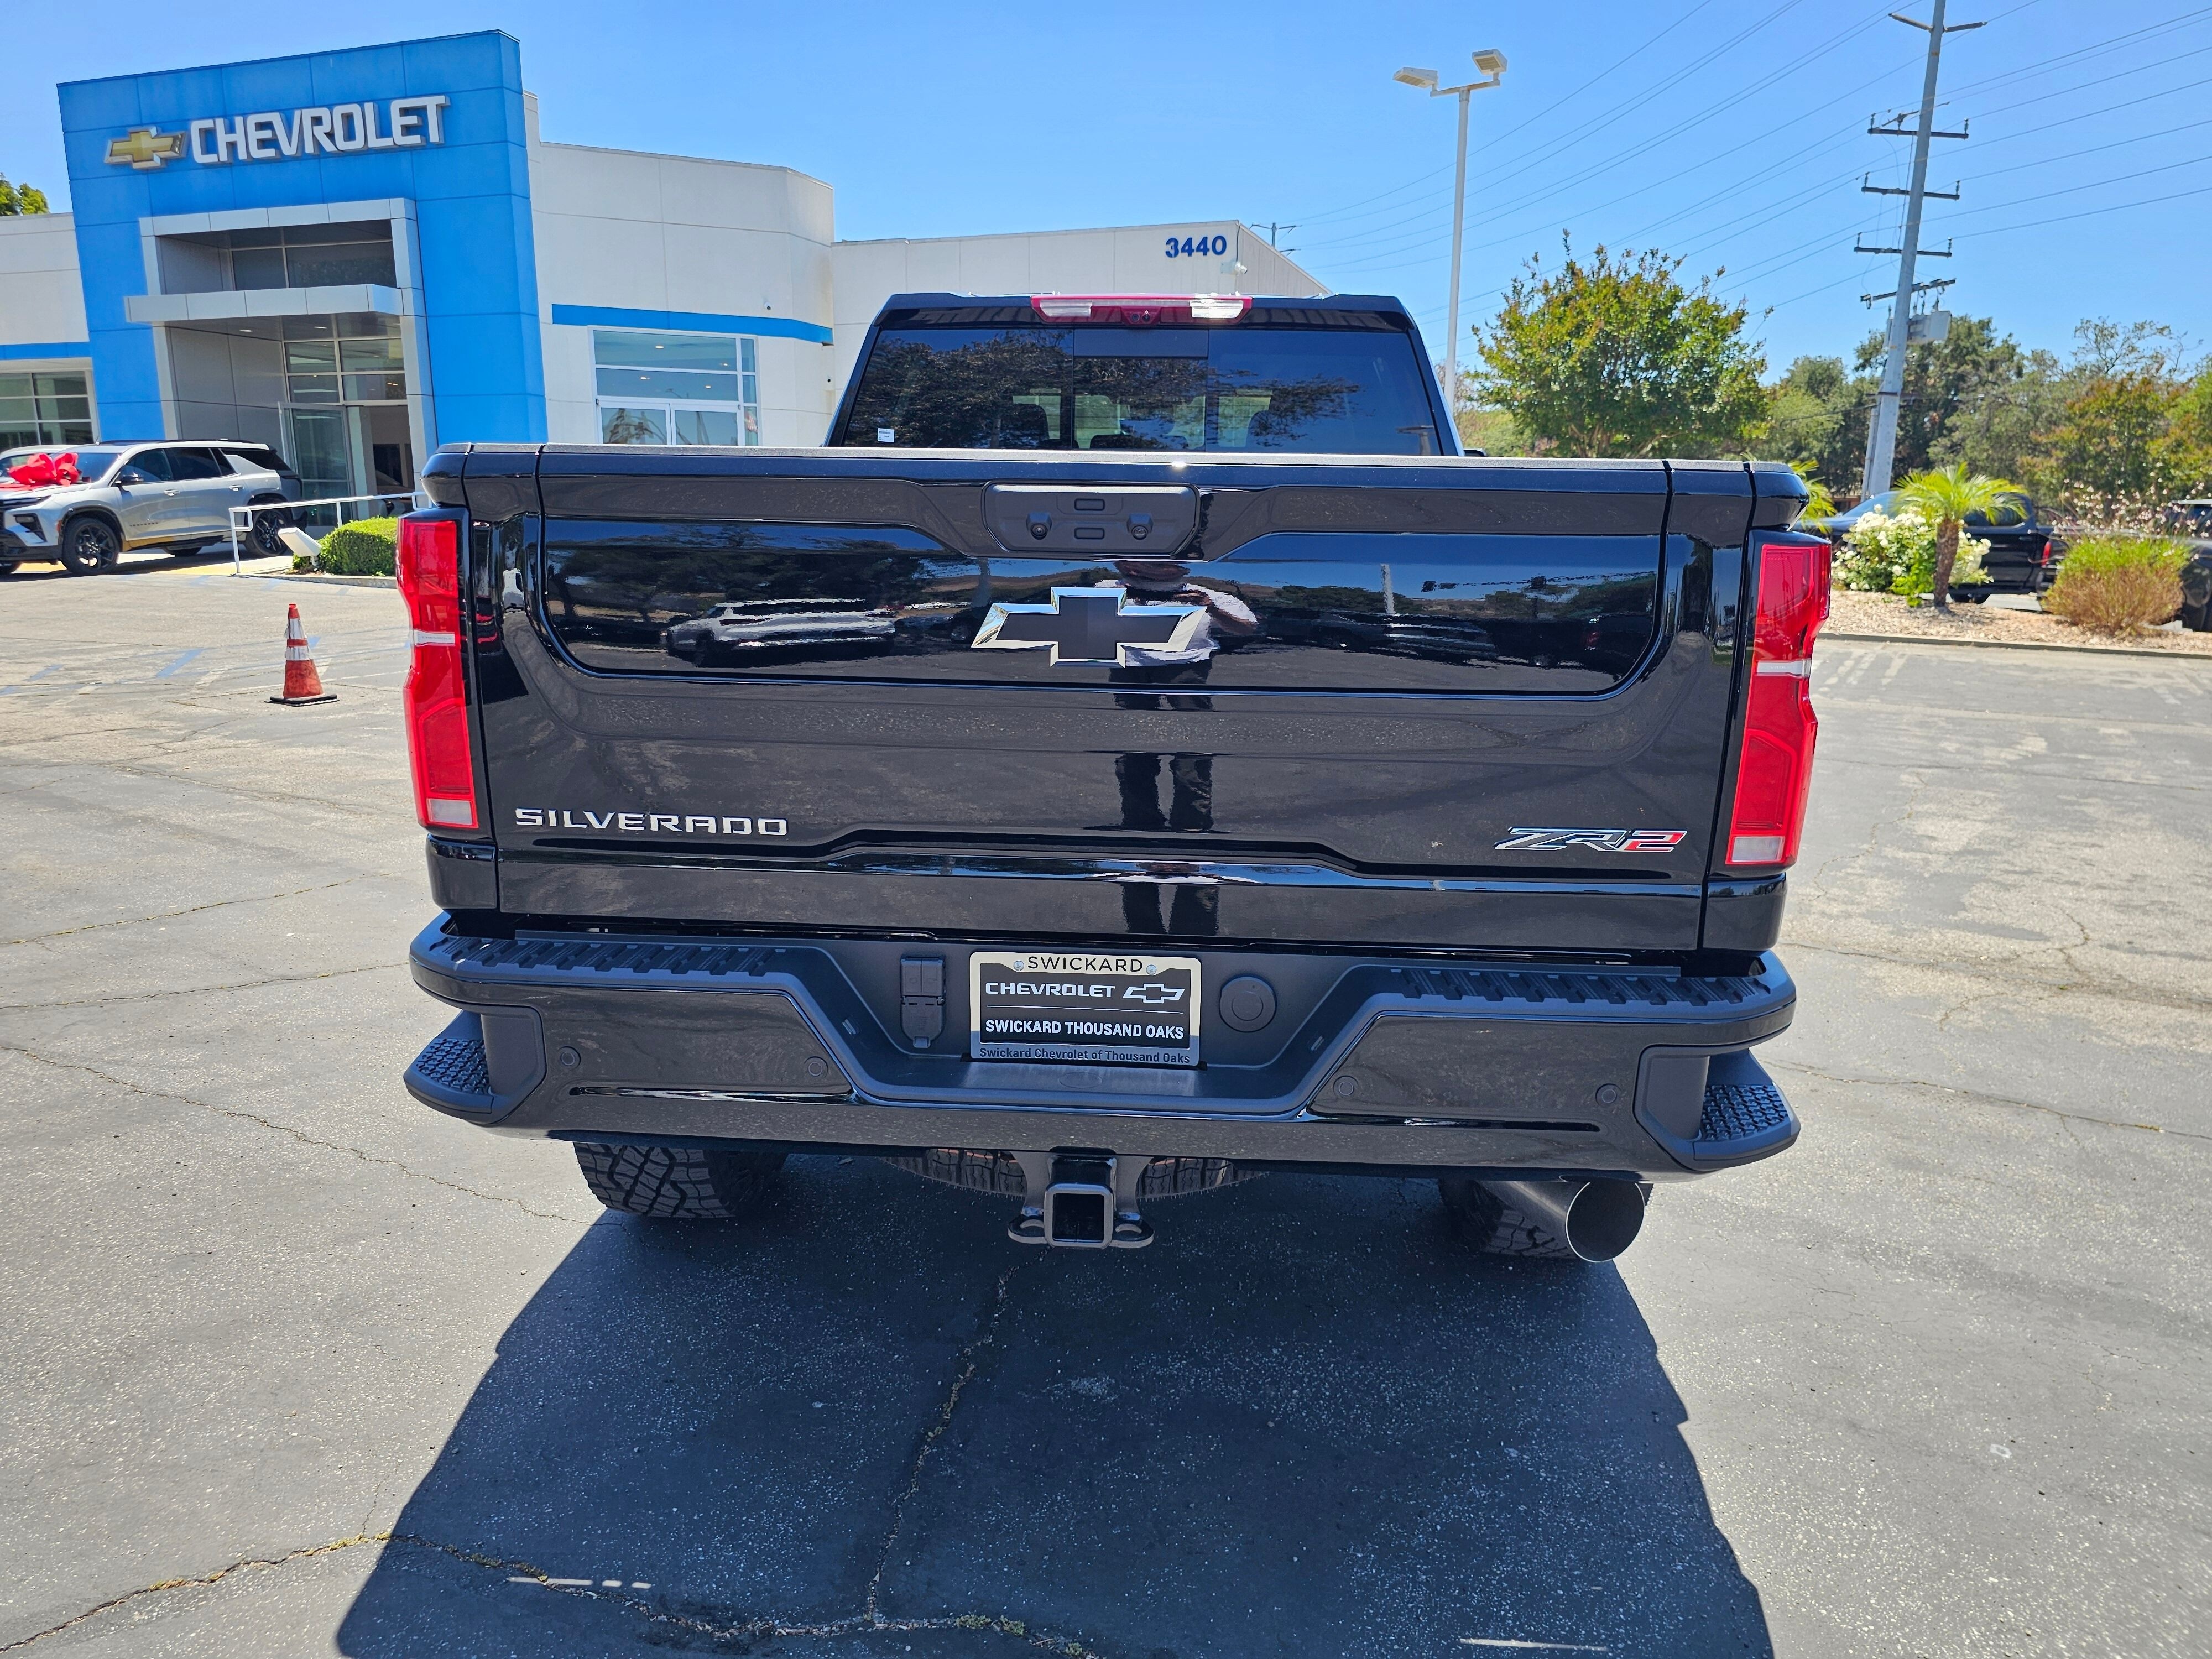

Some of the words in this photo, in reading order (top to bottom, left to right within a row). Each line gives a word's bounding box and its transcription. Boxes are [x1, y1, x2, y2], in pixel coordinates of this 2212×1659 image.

[190, 96, 447, 164] CHEVROLET
[1165, 235, 1227, 258] 3440
[515, 808, 787, 836] SILVERADO
[1494, 827, 1688, 852] ZR2
[1027, 956, 1144, 972] SWICKARD
[985, 982, 1115, 997] CHEVROLET
[985, 1019, 1061, 1034] SWICKARD
[1065, 1021, 1142, 1037] THOUSAND
[1146, 1025, 1184, 1039] OAKS
[979, 1047, 1031, 1059] Swickard
[1034, 1048, 1089, 1061] Chevrolet
[1091, 1050, 1103, 1061] of
[1105, 1050, 1160, 1063] Thousand
[1162, 1053, 1190, 1064] Oaks
